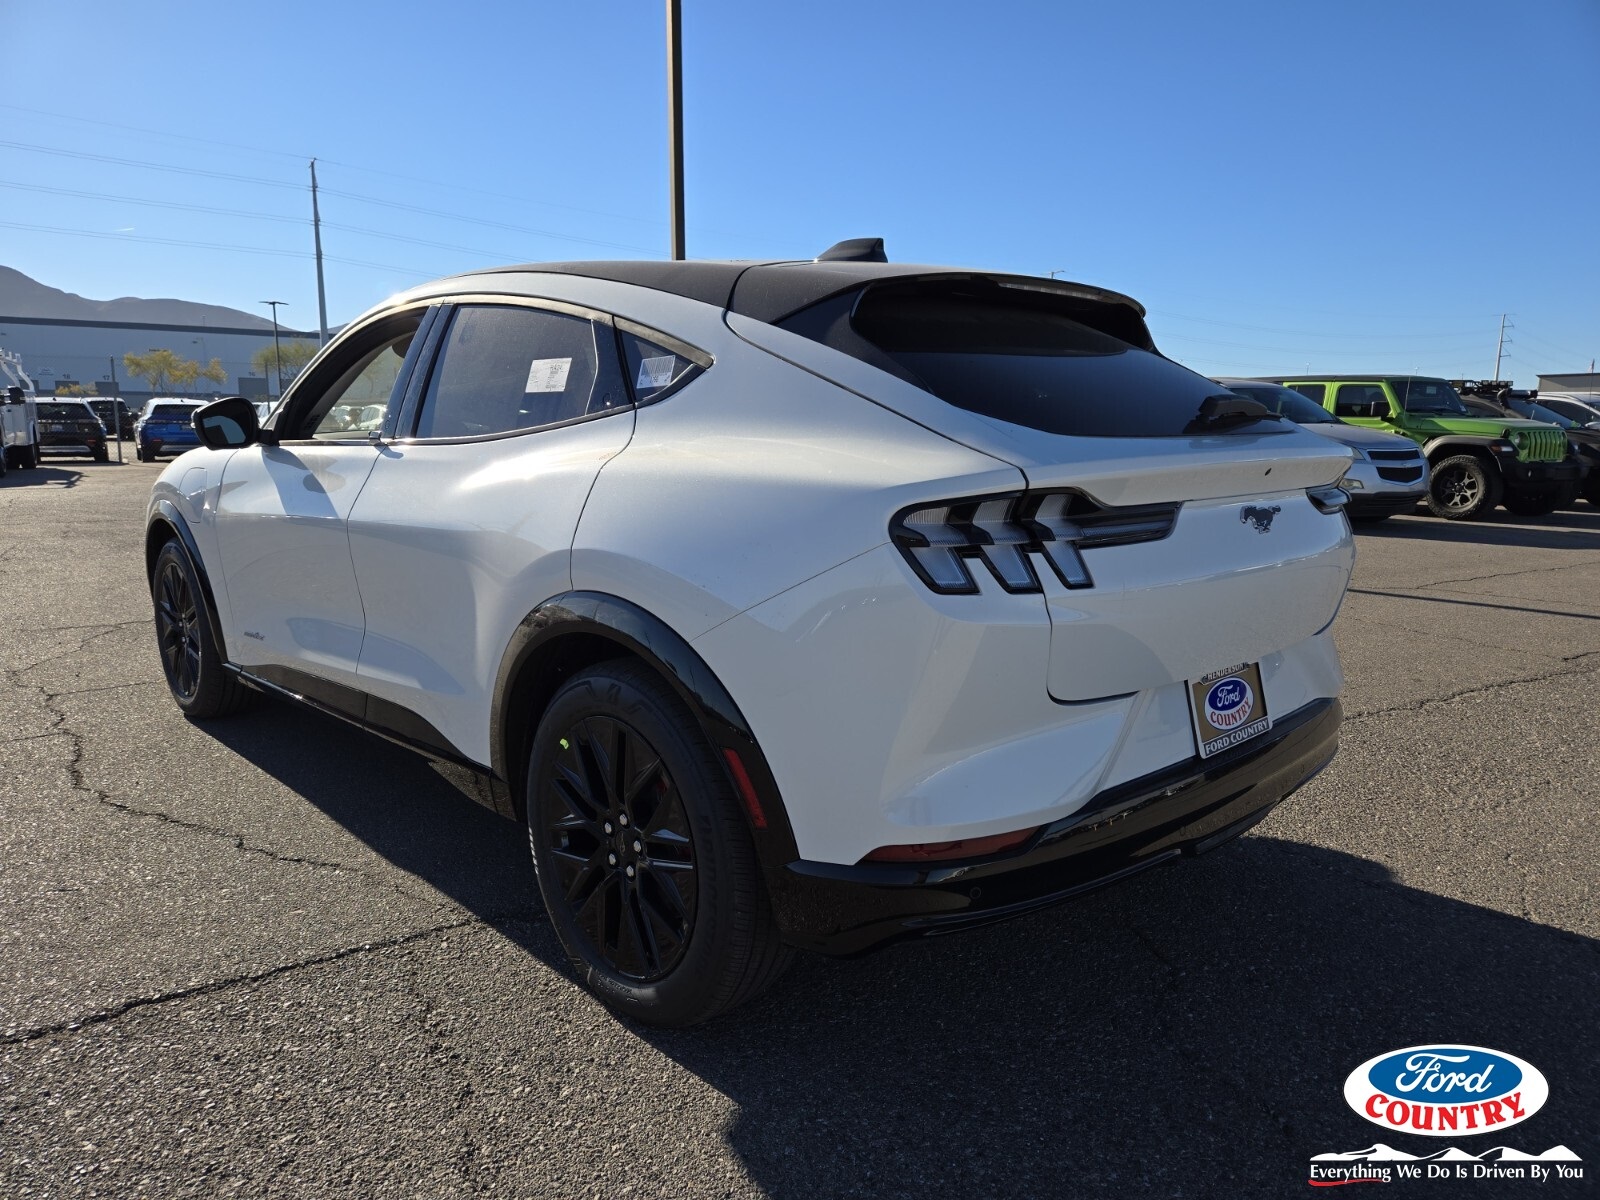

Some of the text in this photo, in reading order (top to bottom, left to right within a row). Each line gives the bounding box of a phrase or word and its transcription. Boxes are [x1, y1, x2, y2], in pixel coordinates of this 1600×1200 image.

[1216, 685, 1241, 708] Ford
[1210, 697, 1252, 726] COUNTRY
[1205, 719, 1269, 755] FORD COUNTRY
